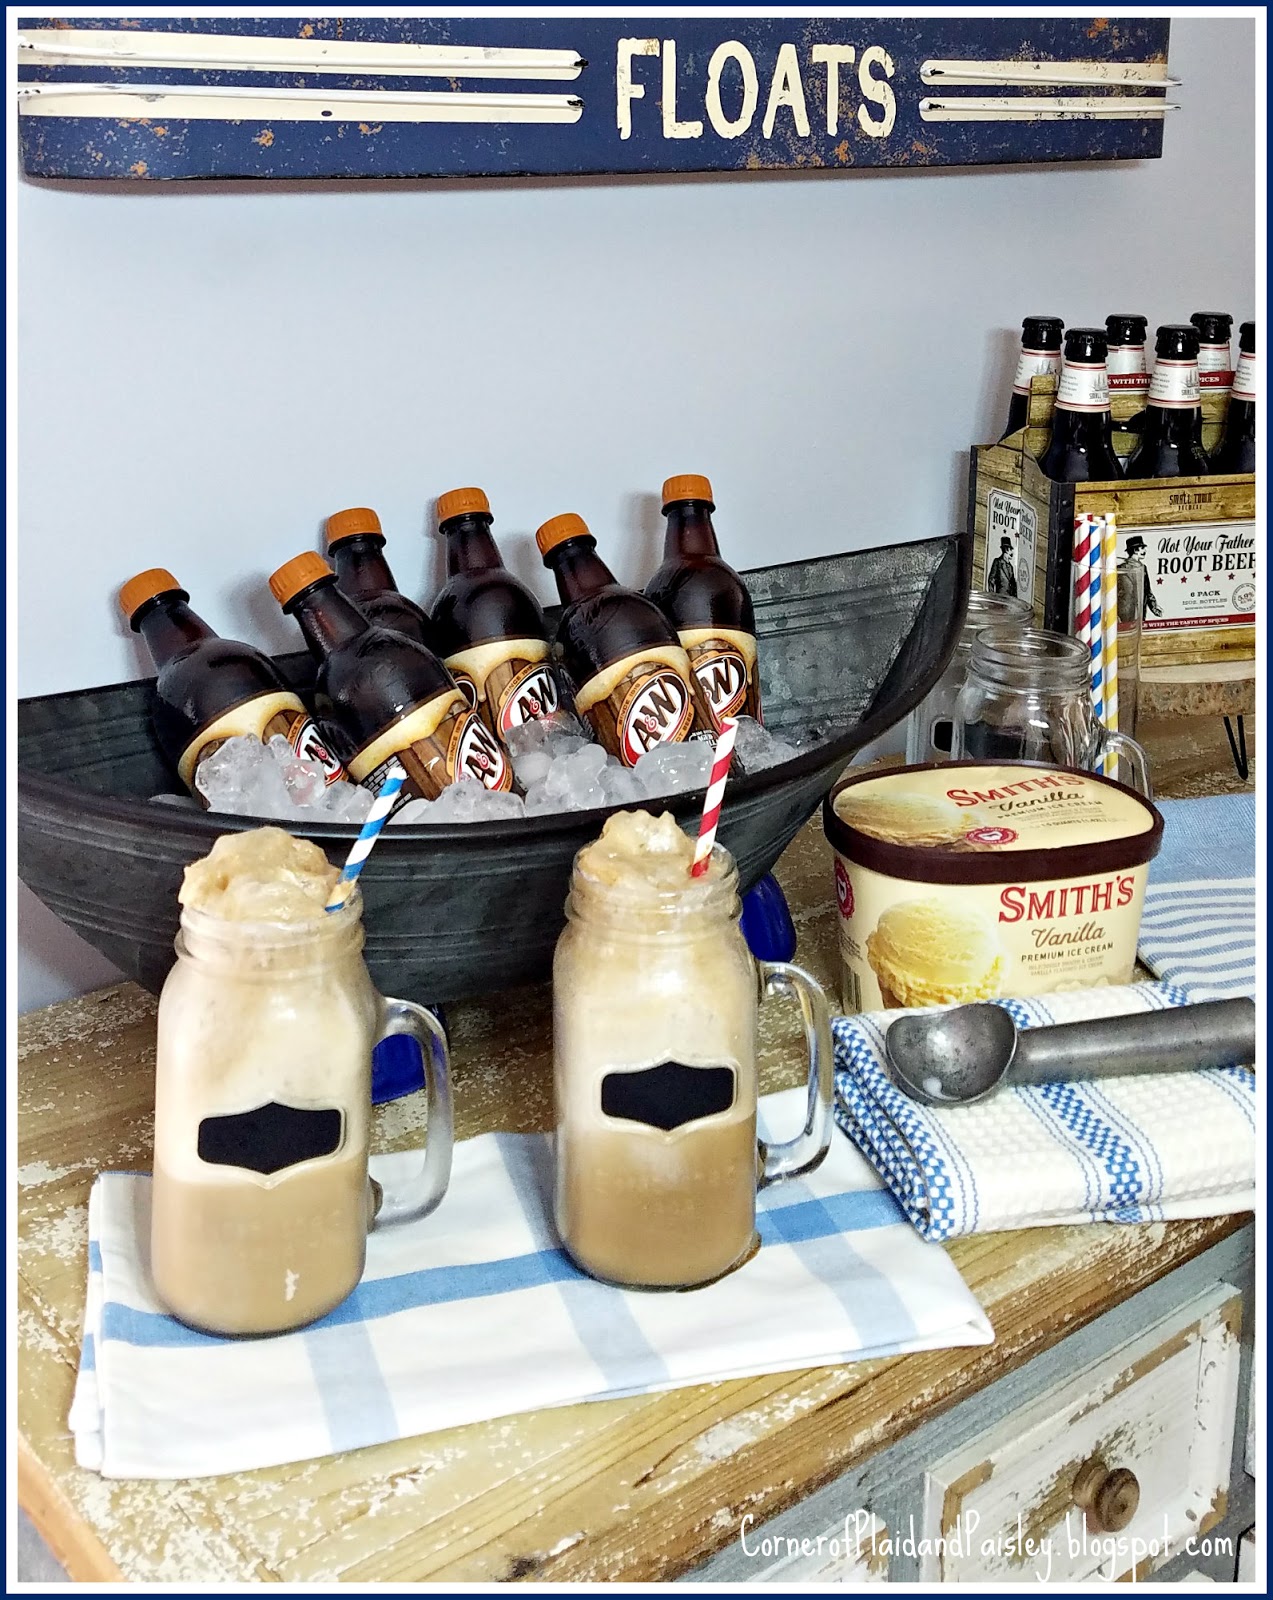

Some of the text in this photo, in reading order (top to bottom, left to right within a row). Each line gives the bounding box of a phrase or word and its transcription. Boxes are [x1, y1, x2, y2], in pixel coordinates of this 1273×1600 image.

[616, 38, 896, 140] FLOATS
[993, 497, 1004, 511] Not
[1004, 500, 1020, 516] Your
[1169, 492, 1191, 505] SMALL
[993, 510, 1017, 530] ROOT
[1158, 537, 1181, 554] Not
[1183, 535, 1213, 556] Your
[1157, 555, 1207, 575] ROOT
[505, 675, 521, 697] SINCE
[517, 667, 556, 724] A&W
[618, 700, 630, 726] SINCE
[632, 676, 679, 753] A&W
[682, 712, 693, 731] BEER
[448, 736, 458, 763] SINCE
[465, 716, 498, 782] A&W
[946, 774, 1086, 808] SMITH'S
[989, 791, 1085, 812] Vanilla
[997, 807, 1045, 819] PREMIUM
[1067, 800, 1104, 808] CREAM
[999, 875, 1135, 923] SMITH'S
[1031, 920, 1106, 948] Vanilla
[1021, 942, 1114, 963] PREMIUM ICE CREAM
[1030, 968, 1053, 977] VANILLA
